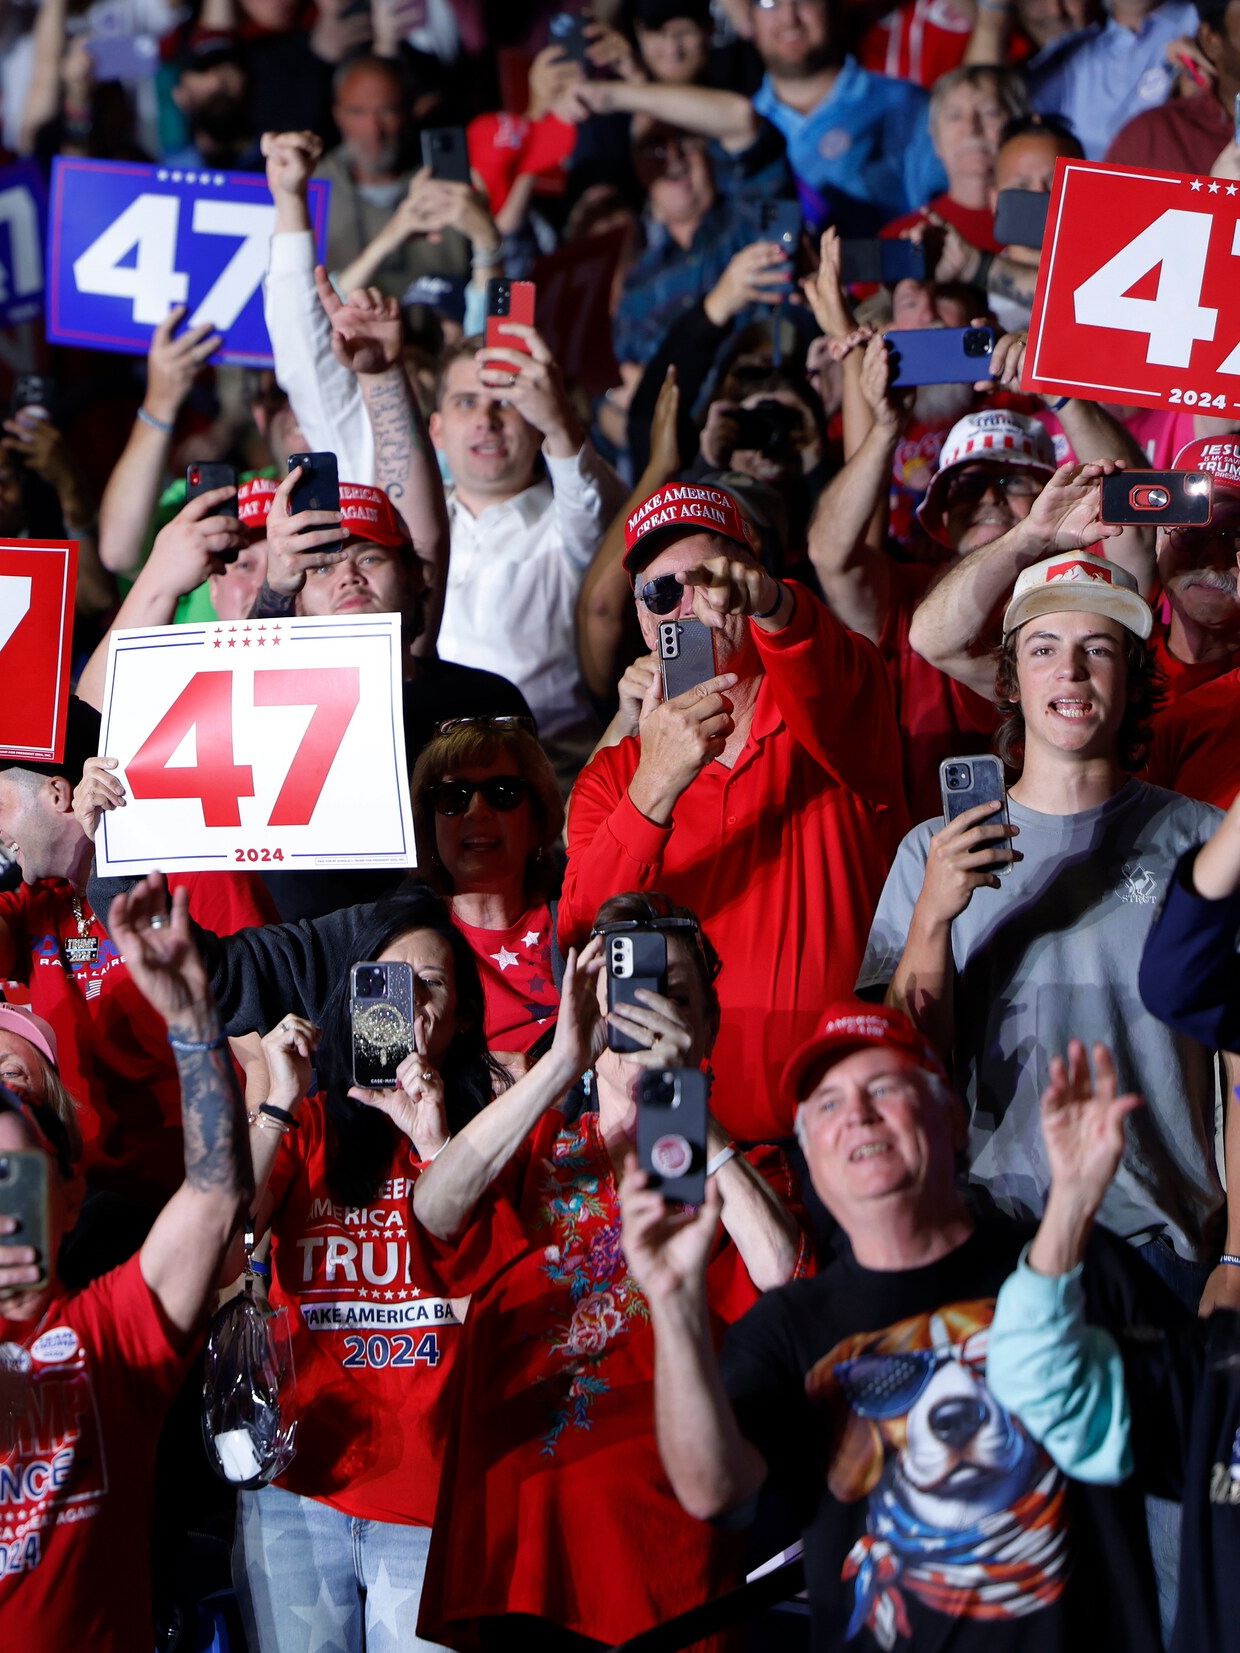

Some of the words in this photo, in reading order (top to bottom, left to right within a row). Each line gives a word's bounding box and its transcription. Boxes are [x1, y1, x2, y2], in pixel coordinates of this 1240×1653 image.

[73, 192, 277, 333] 47
[1168, 388, 1227, 410] 2024
[628, 493, 662, 532] MAKE
[663, 486, 732, 509] AMERICA
[636, 505, 677, 538] GREAT
[680, 503, 727, 525] AGAIN
[125, 666, 361, 828] 47
[235, 847, 285, 863] 2024
[307, 1198, 404, 1229] AMERICA
[296, 1235, 412, 1286] TRU
[303, 1308, 342, 1326] TAKE
[345, 1304, 429, 1325] AMERICA
[433, 1303, 454, 1320] BA
[342, 1333, 440, 1369] 2024
